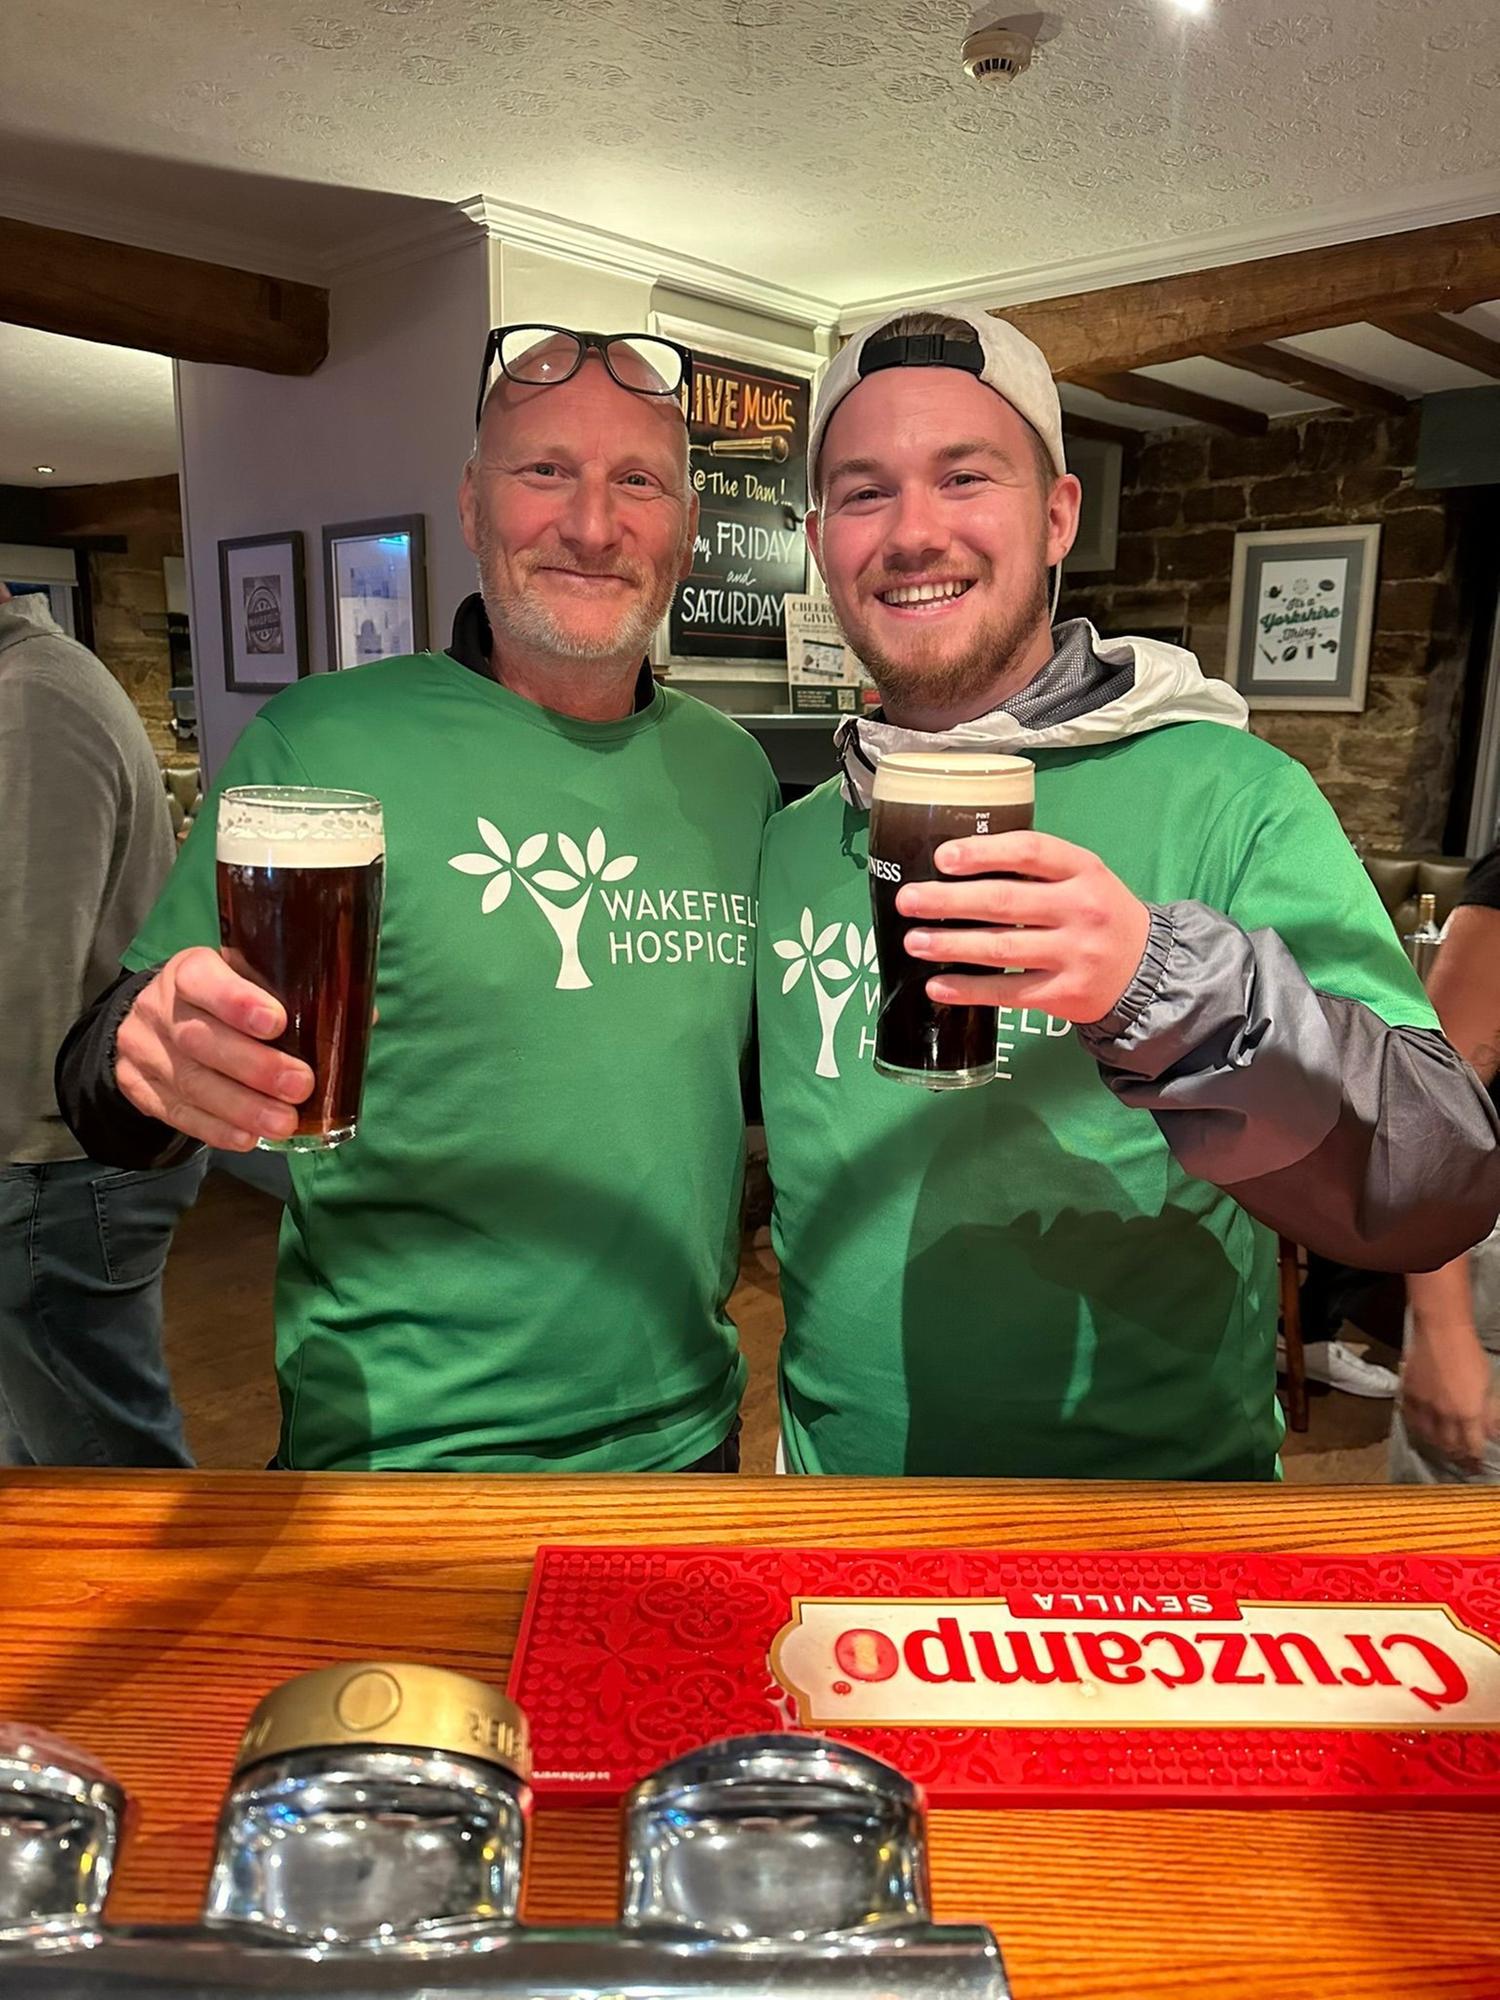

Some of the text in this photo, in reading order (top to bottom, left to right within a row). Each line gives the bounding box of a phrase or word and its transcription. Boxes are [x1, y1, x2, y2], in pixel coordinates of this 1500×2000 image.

[717, 521, 796, 563] FRIDAY
[726, 567, 757, 586] and
[681, 586, 786, 627] SATURDAY
[1260, 605, 1340, 634] Yorkshire
[868, 855, 901, 882] NESS
[609, 930, 747, 966] HOSPICE
[1031, 1592, 1214, 1614] SEVILLA
[834, 1617, 1469, 1712] Cruzcampo
